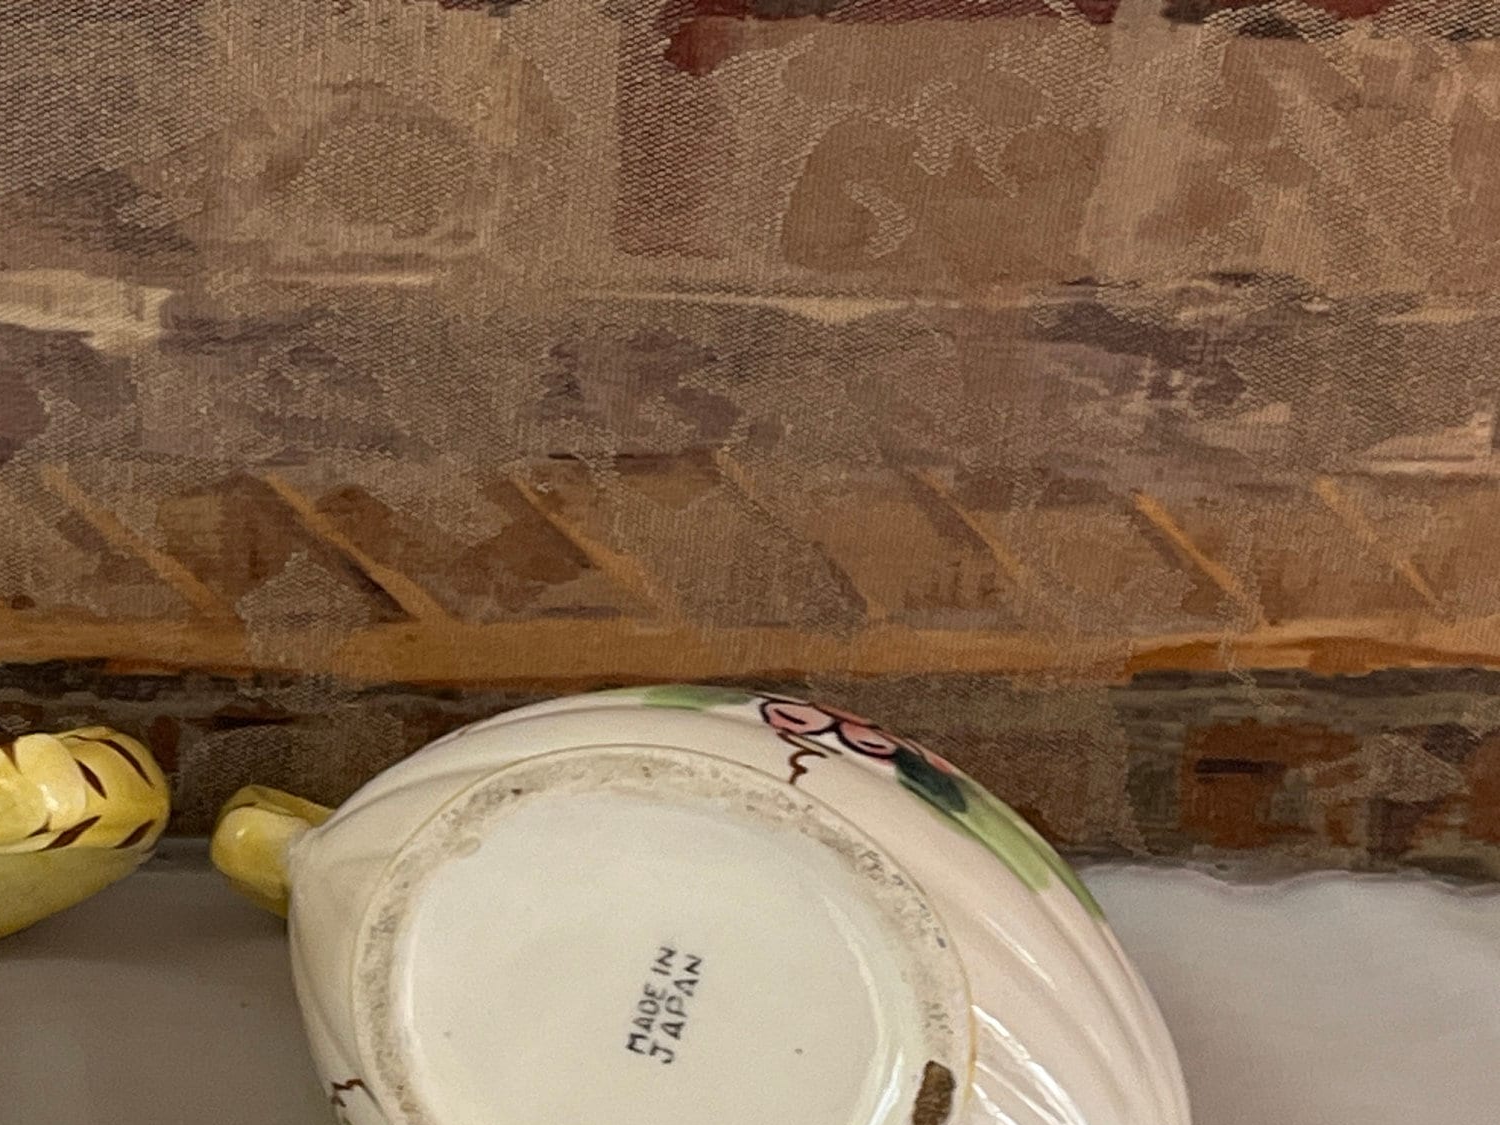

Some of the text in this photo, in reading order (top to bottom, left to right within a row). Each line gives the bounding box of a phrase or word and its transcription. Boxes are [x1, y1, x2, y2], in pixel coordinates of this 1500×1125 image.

[625, 946, 677, 1055] MADE IN
[648, 954, 703, 1064] JAPAN
